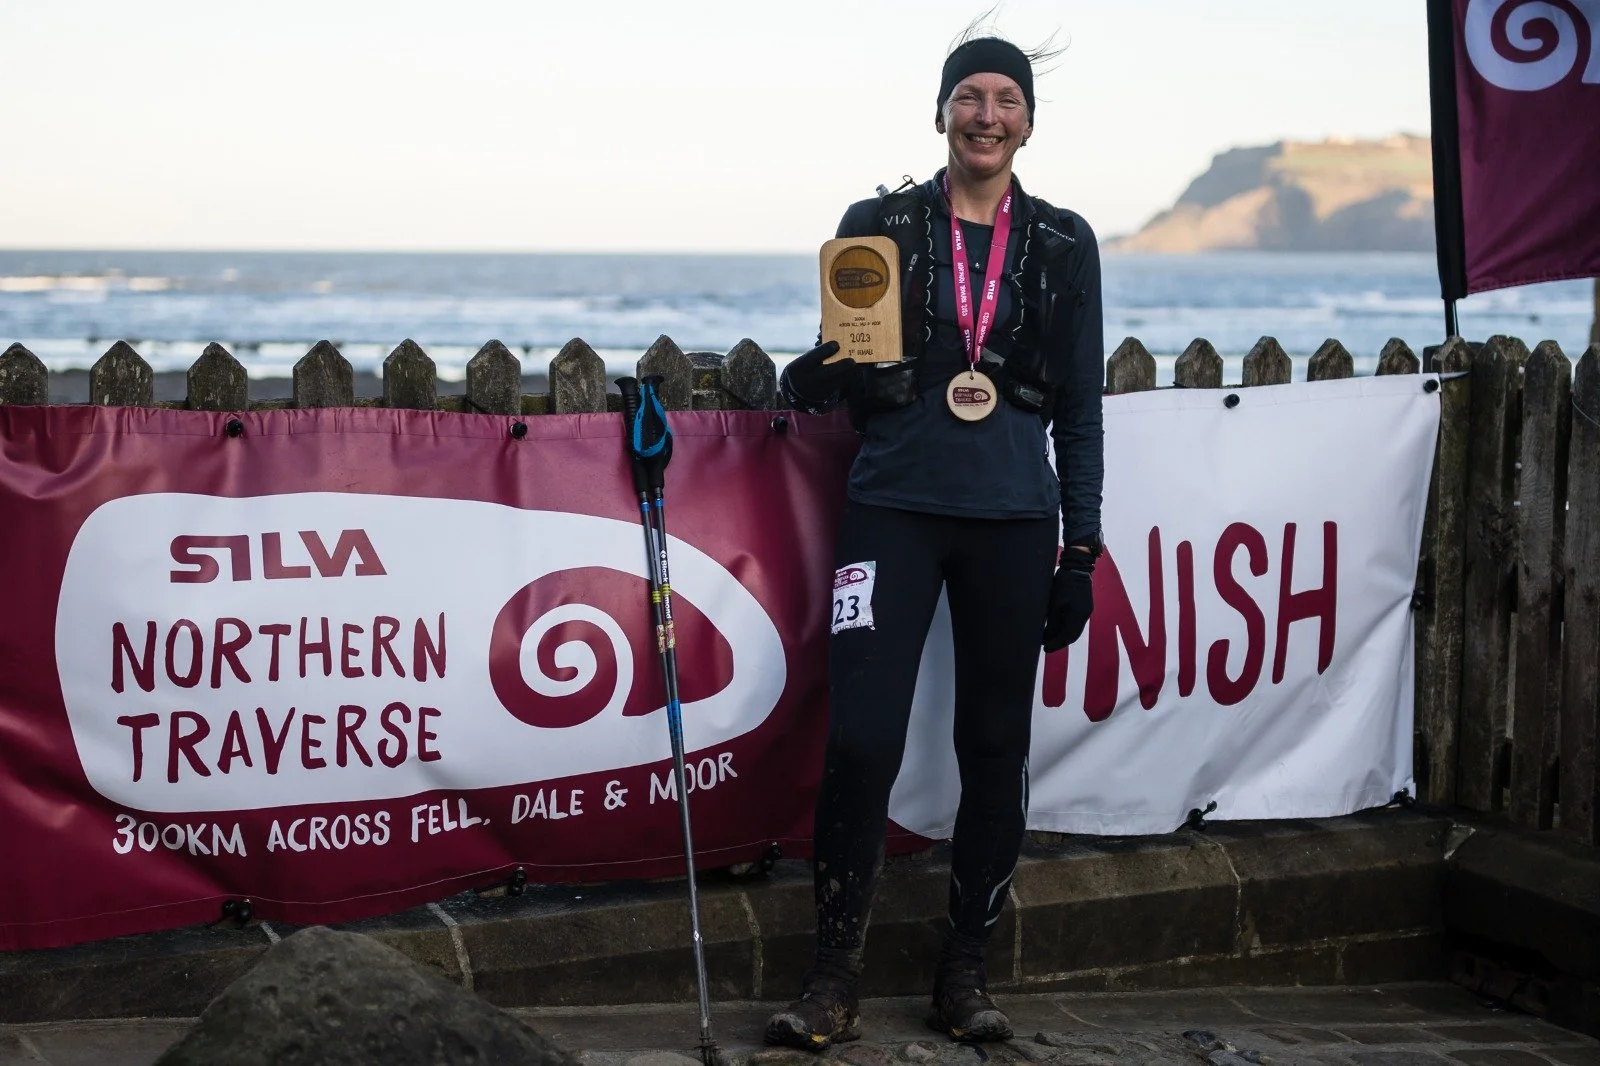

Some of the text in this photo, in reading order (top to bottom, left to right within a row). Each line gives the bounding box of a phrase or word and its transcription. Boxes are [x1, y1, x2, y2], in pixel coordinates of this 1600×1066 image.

[884, 214, 911, 227] VIA
[954, 229, 963, 251] SILVA
[985, 280, 996, 301] SILVA
[849, 332, 871, 343] 2023
[964, 329, 972, 351] SILVA
[170, 528, 387, 584] SILVA
[661, 560, 669, 583] Black
[833, 595, 860, 627] 23
[1042, 520, 1338, 723] NISH
[111, 611, 447, 693] NORTHERN
[117, 702, 442, 783] TRAVERSE
[112, 813, 247, 857] 300KM
[266, 811, 391, 852] ACROSS
[511, 788, 584, 824] DALE
[603, 780, 628, 811] &
